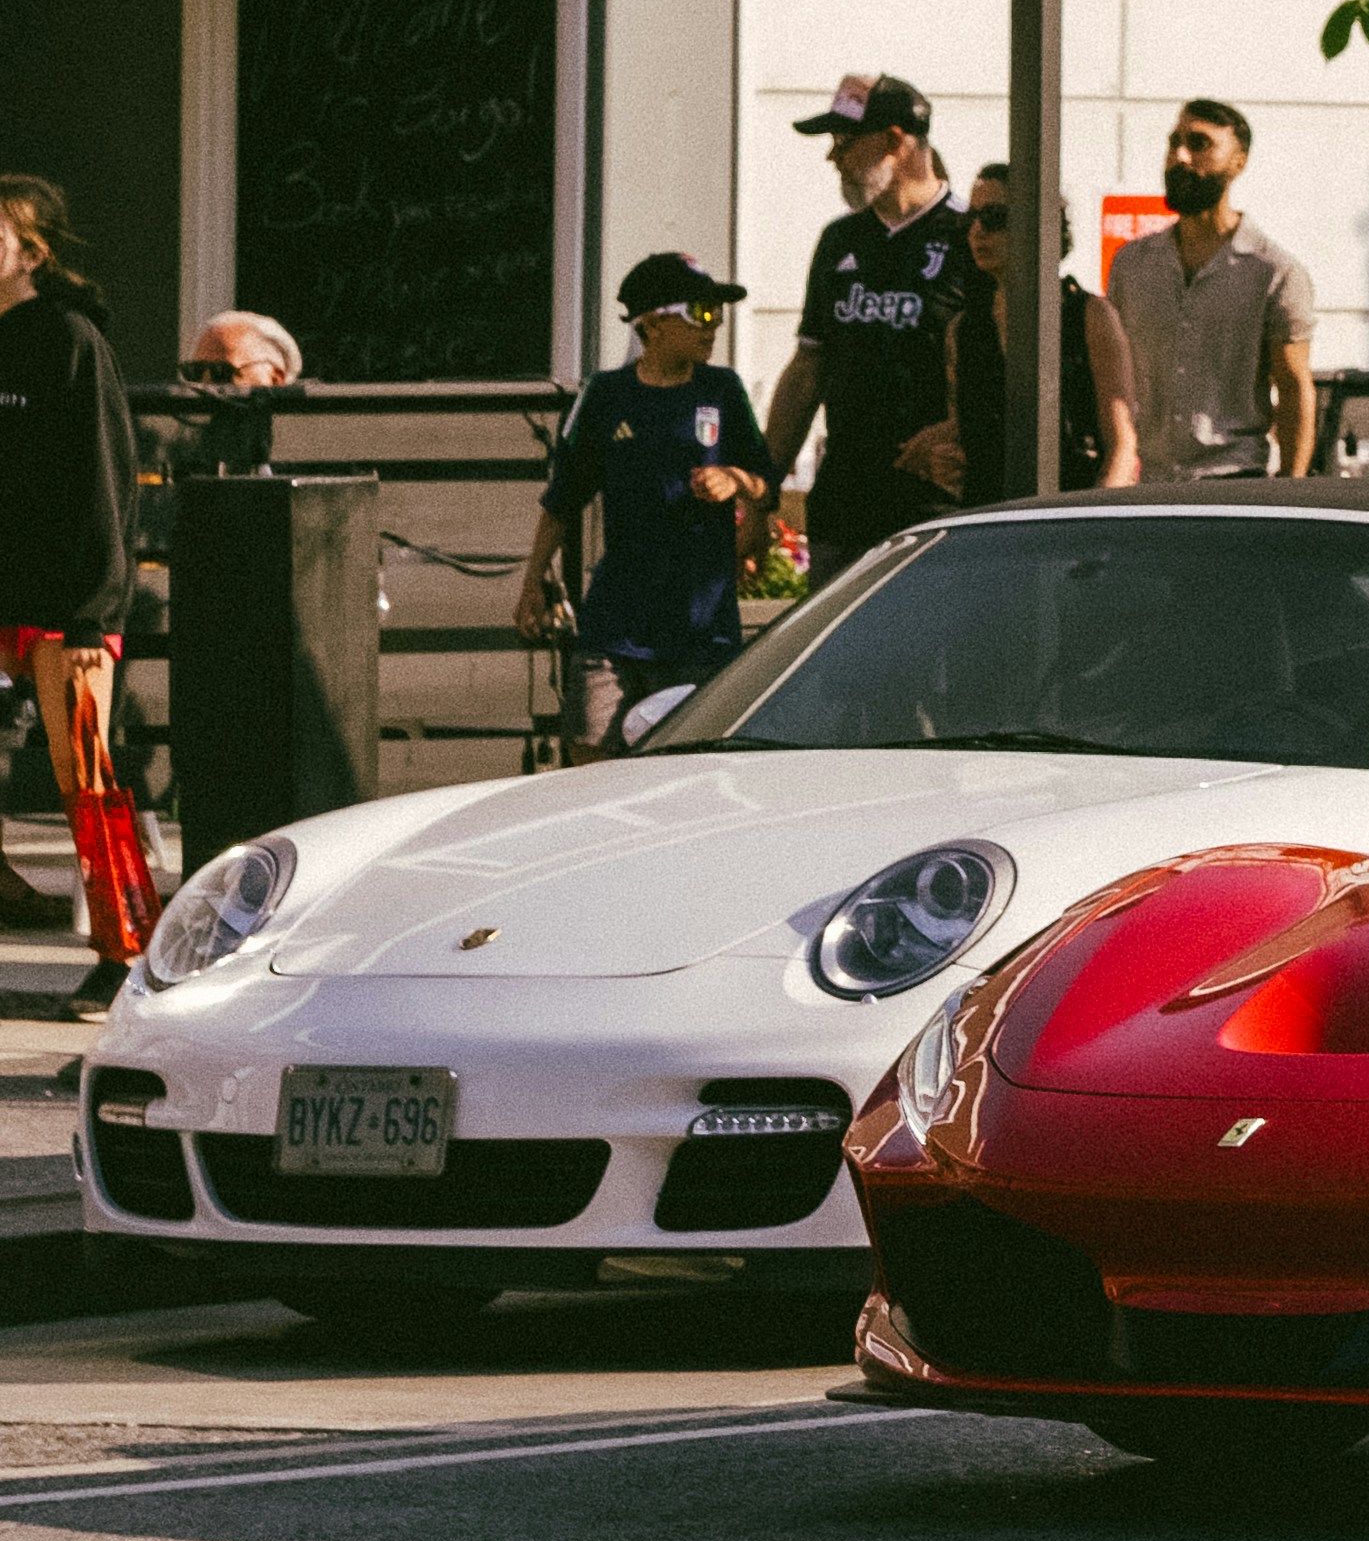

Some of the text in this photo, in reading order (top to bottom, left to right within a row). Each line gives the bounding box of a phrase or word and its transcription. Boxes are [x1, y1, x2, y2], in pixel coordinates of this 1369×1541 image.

[834, 282, 923, 329] Jeep
[288, 1094, 440, 1146] BYKZ 696
